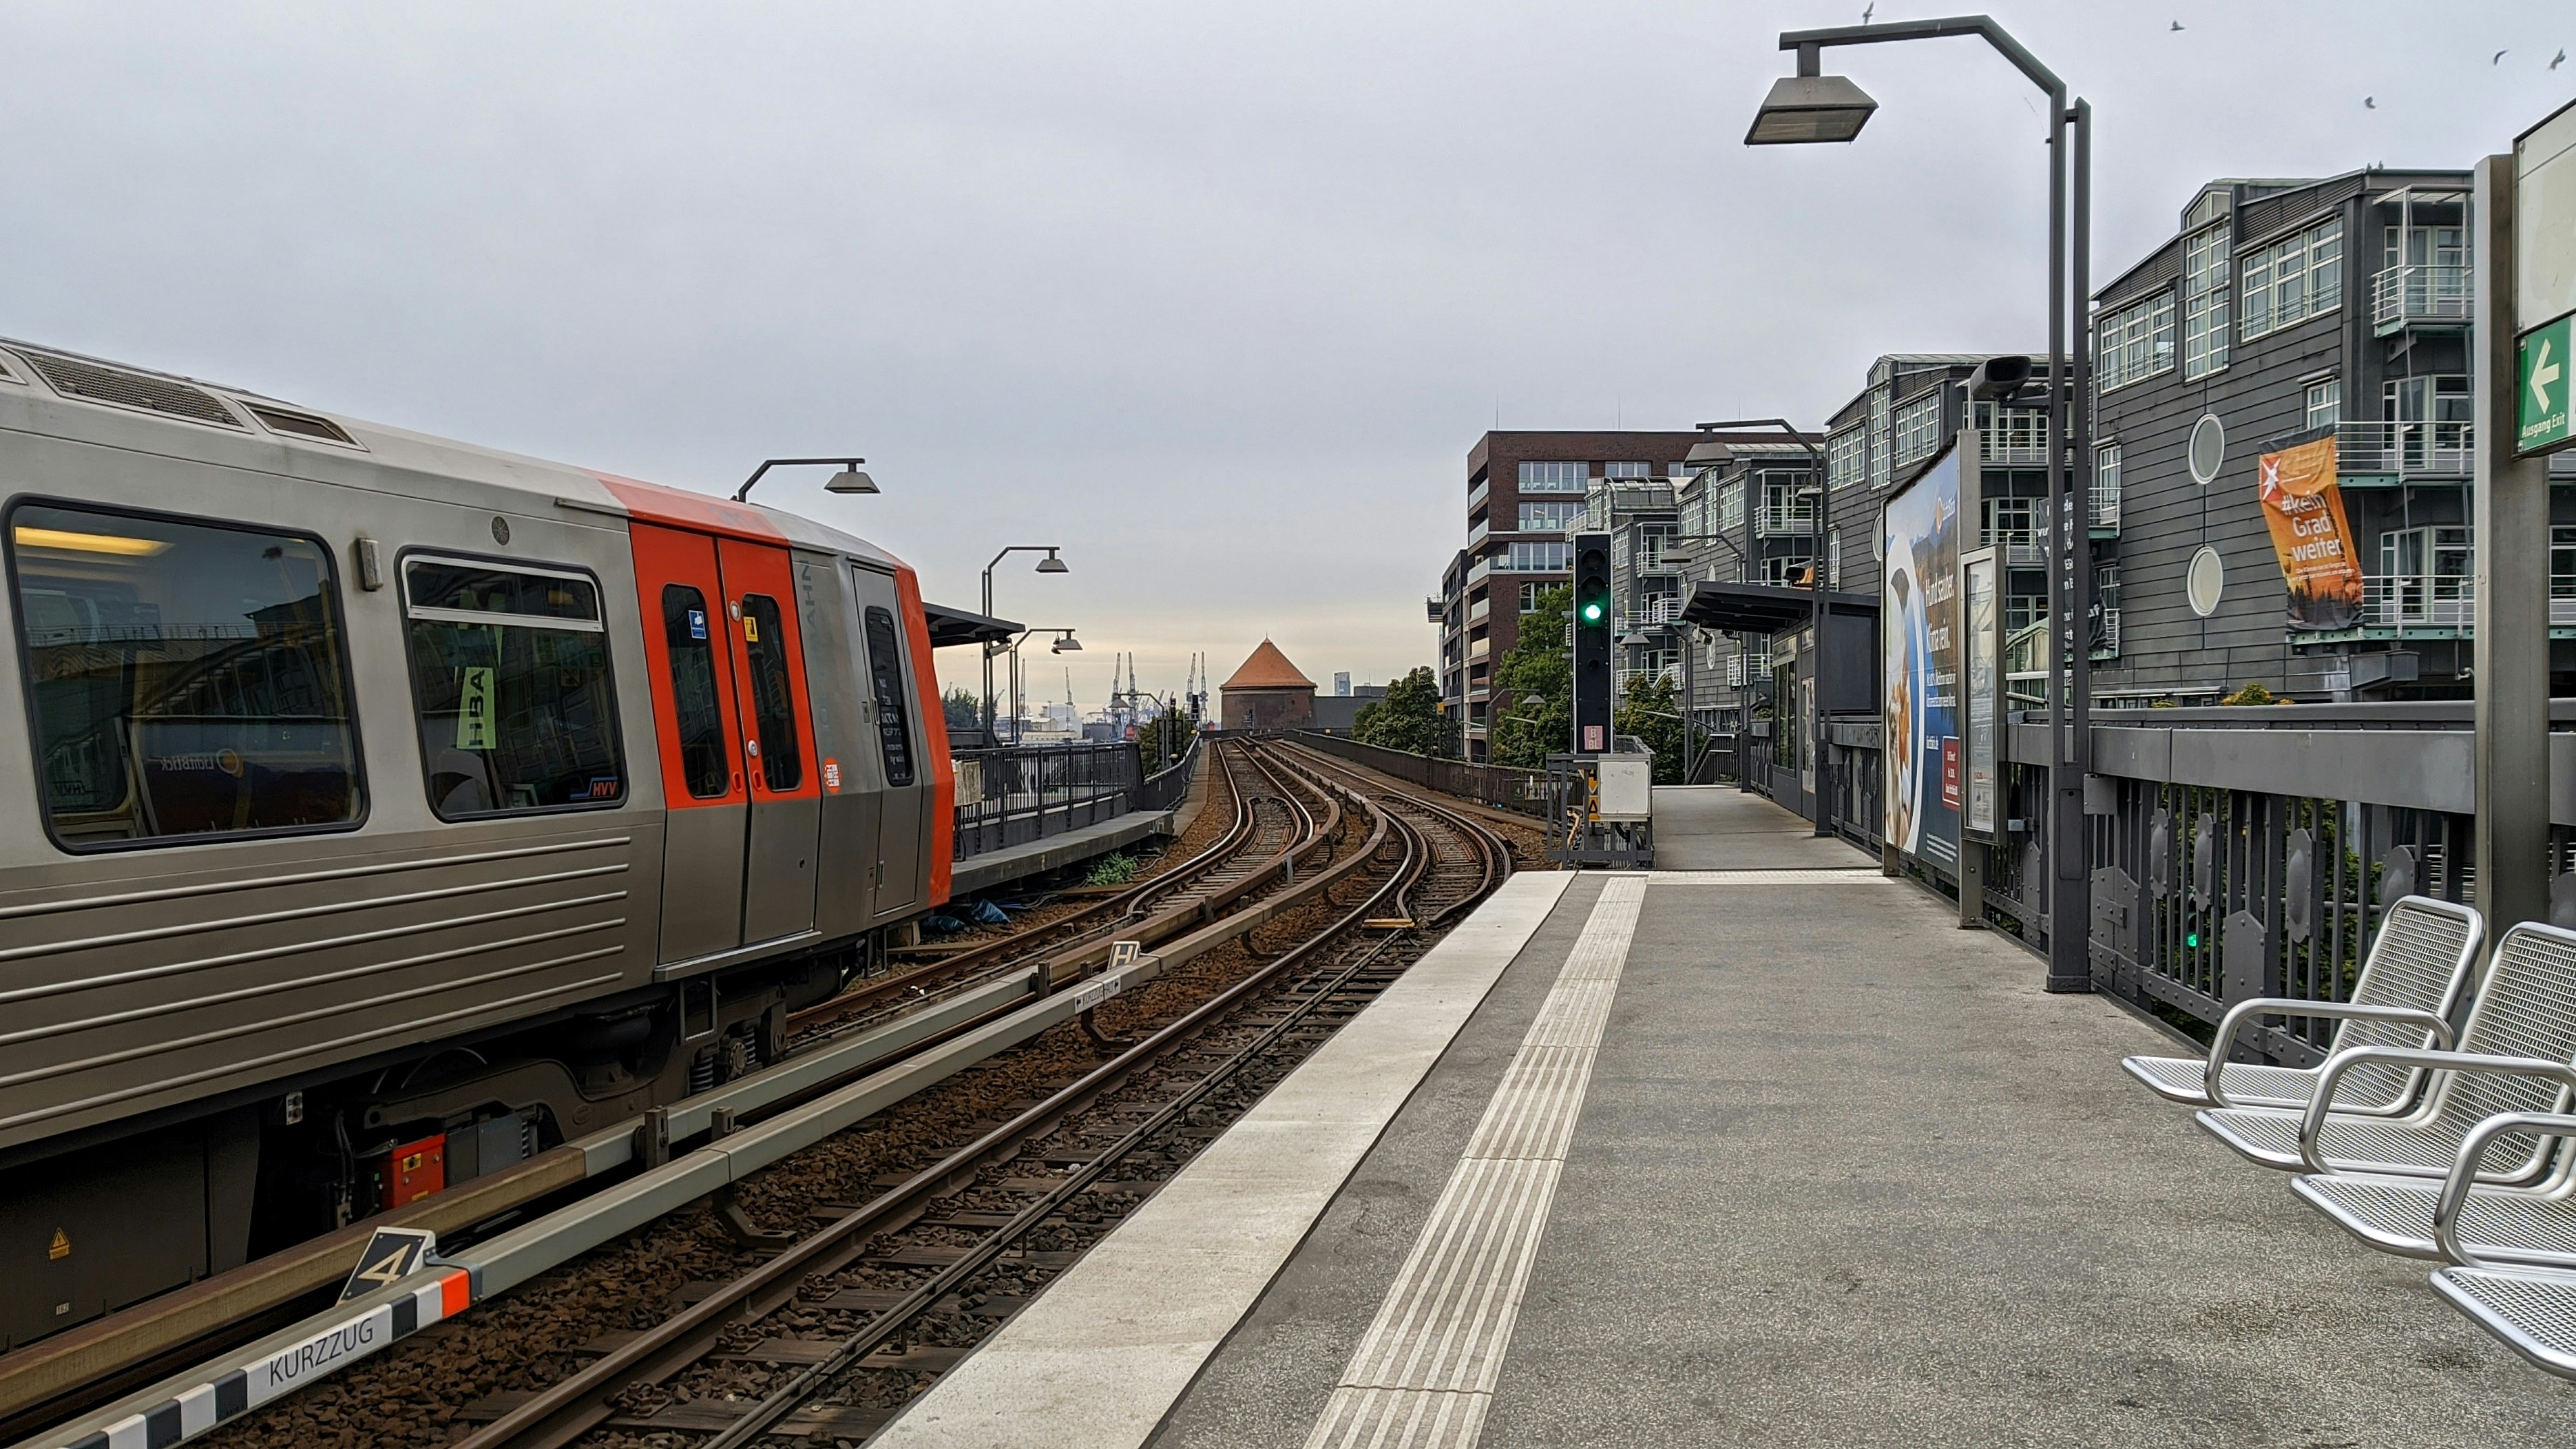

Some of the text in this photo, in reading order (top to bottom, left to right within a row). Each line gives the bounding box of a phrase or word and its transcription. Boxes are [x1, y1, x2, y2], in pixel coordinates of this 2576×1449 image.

[2522, 411, 2566, 438] Ausgang Exit
[2281, 490, 2327, 515] #kein
[2292, 510, 2332, 537] Grad
[2292, 536, 2341, 562] weiter
[1925, 572, 1938, 607] Hund
[1589, 740, 1599, 749] BL
[1590, 728, 1597, 738] B
[593, 781, 618, 796] HVV
[1111, 945, 1133, 968] H
[357, 1243, 412, 1287] 4
[270, 1317, 373, 1387] KURZZUG
